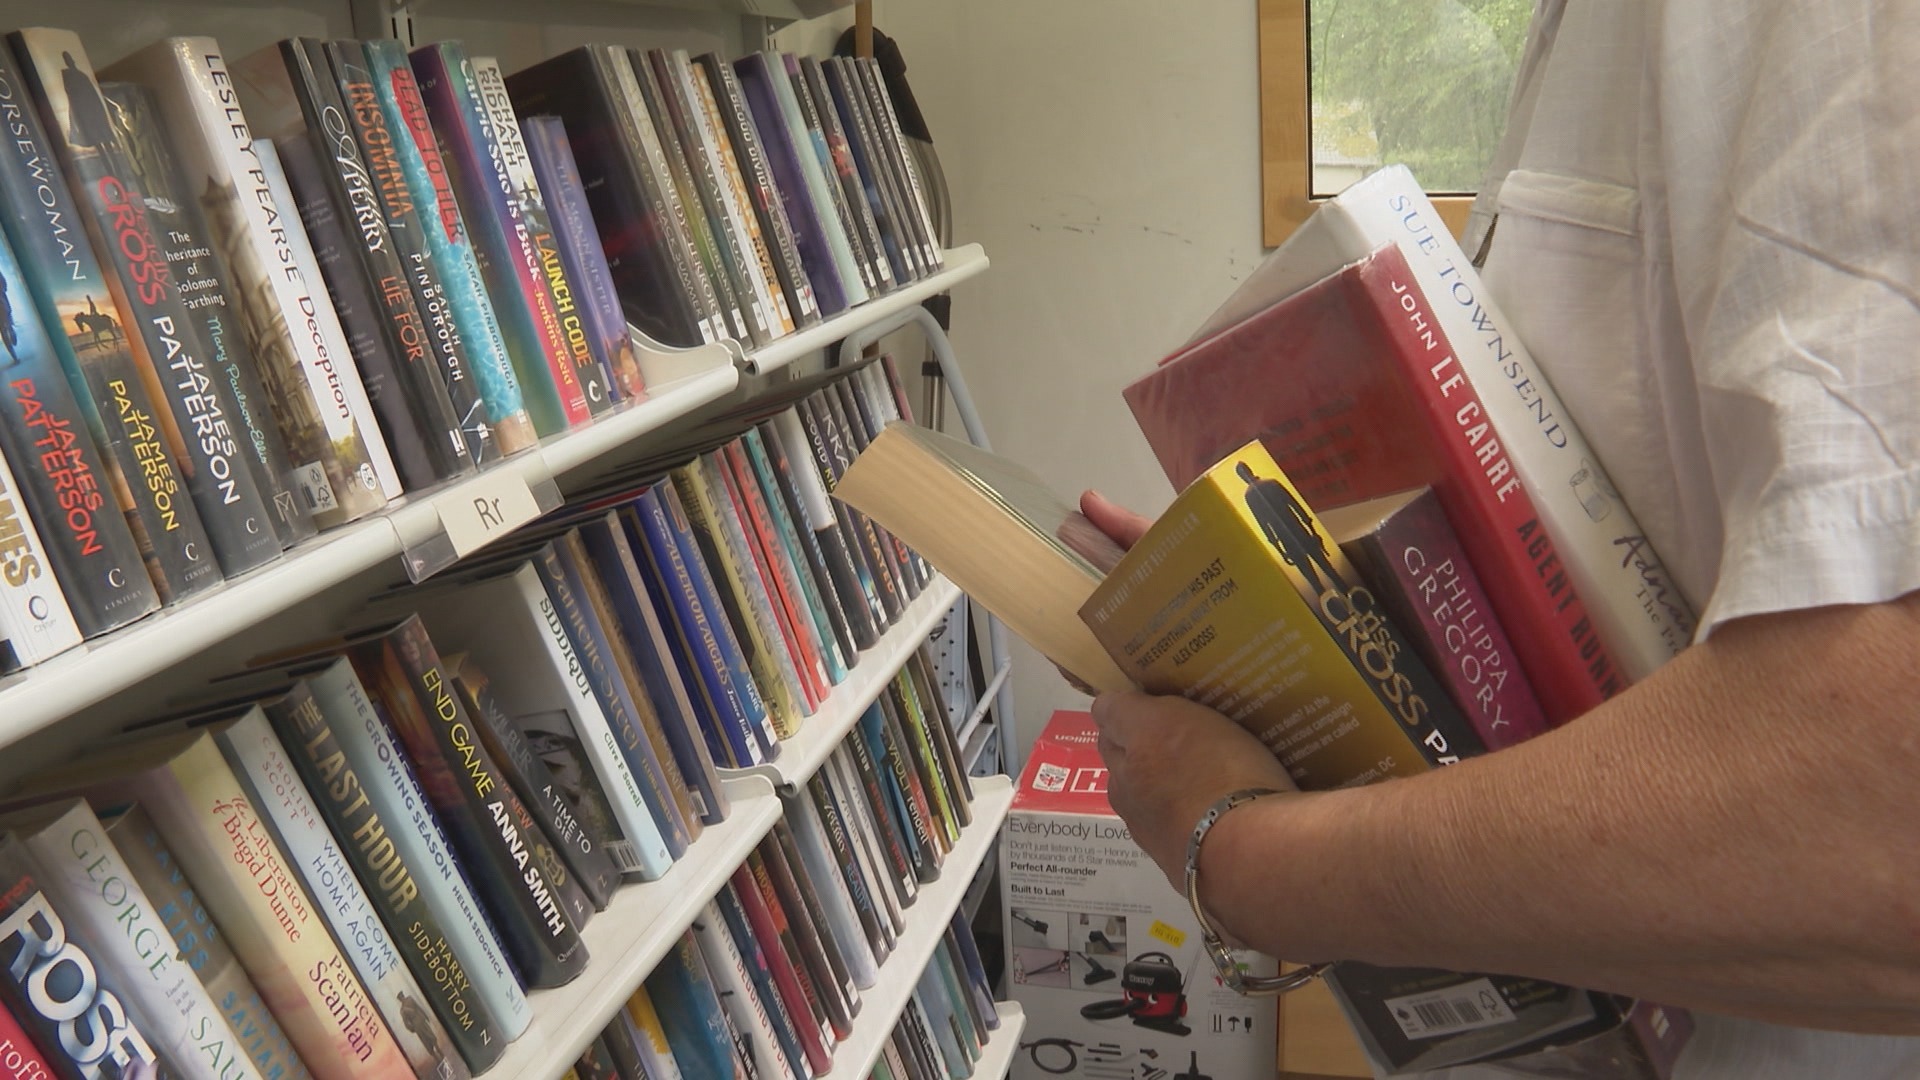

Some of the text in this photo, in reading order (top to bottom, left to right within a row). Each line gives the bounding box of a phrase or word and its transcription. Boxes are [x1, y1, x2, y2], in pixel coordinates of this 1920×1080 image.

[346, 82, 414, 218] INSOMNIA
[393, 67, 427, 132] DEAD
[421, 145, 442, 175] TO
[437, 187, 469, 244] HER
[478, 71, 517, 166] RIDPATH
[488, 67, 527, 168] MICHAEL
[343, 171, 388, 255] PERRY
[460, 59, 542, 285] Carrie Soto is Back
[745, 147, 773, 195] DIVIDE
[777, 238, 804, 286] DHAND
[100, 176, 166, 305] CROSS
[169, 231, 190, 244] The
[187, 264, 199, 276] of
[204, 54, 257, 158] LESLEY
[248, 169, 300, 283] PEARSE
[298, 295, 350, 419] Deception
[654, 200, 706, 319] BLACK SUMMER
[718, 217, 758, 292] LEGACY
[207, 315, 228, 363] Mary
[381, 276, 403, 307] LIE
[394, 312, 424, 362] FOR
[411, 253, 463, 382] PINBOROUGH
[434, 284, 461, 345] SARAH
[464, 254, 515, 390] SARAH PINBOROUGH
[535, 234, 575, 314] LAUNCH
[564, 315, 593, 368] CODE
[1389, 195, 1568, 450] SUE TOWNSEND
[153, 315, 241, 505] PATTERSON
[184, 356, 237, 457] JAMES
[556, 351, 573, 385] Reid
[10, 378, 103, 556] PATTERSON
[50, 414, 104, 512] JAMES
[109, 380, 180, 531] PATTERSON
[132, 410, 179, 495] JAMES
[802, 414, 828, 463] COULD
[1391, 279, 1583, 612] JOHN LE CARRÉ AGENT
[474, 498, 504, 530] Rr
[731, 565, 777, 654] JAMES
[765, 538, 811, 623] JAMES
[783, 528, 828, 612] JAMES
[1186, 558, 1226, 596] HIS PAST
[1633, 584, 1662, 622] The
[1147, 617, 1194, 659] EVERYTHING
[1207, 578, 1238, 606] FROM
[1171, 624, 1219, 667] ALEX CROSS?
[1319, 589, 1430, 726] CROSS
[1347, 586, 1400, 664] Criss
[1403, 545, 1509, 731] GREGORY
[1435, 558, 1508, 692] PHILIPPA
[540, 598, 642, 807] SIDDIQUI Clive Sorrell
[744, 683, 760, 711] HARE
[1312, 698, 1353, 734] campaign
[1313, 691, 1330, 710] the
[1332, 715, 1360, 740] called
[260, 737, 317, 829] CAROLINE
[260, 760, 300, 820] SCOTT
[285, 696, 421, 912] THE LAST HOUR
[420, 667, 567, 936] END GAME ANNA SMITH
[540, 783, 593, 855] A TIME TO
[902, 796, 932, 844] rendell
[230, 794, 311, 922] The Liberation
[343, 680, 368, 716] THE
[362, 718, 416, 809] GROWING
[410, 811, 453, 880] SEASON
[451, 886, 474, 921] HELEN
[470, 922, 504, 978] SEDGWICK
[551, 814, 574, 845] DIE
[1009, 817, 1090, 841] Everybody
[1010, 862, 1097, 876] Perfect All-rounder
[1022, 852, 1068, 863] thousands
[1086, 855, 1103, 866] Star
[1105, 857, 1138, 868] reviews
[1104, 847, 1130, 859] Henry
[71, 828, 172, 981] GEORGE
[144, 832, 217, 941] SAVAGE
[217, 815, 264, 879] Brigid
[258, 876, 304, 944] Dunne
[310, 856, 388, 981] HOME AGAIN
[319, 840, 359, 899] WHEN
[361, 913, 401, 972] COME
[1010, 884, 1065, 898] Built to Last
[160, 901, 209, 970] KISS
[408, 922, 474, 1031] SIDEBOTTOM
[433, 936, 469, 992] HARRY
[307, 962, 376, 1062] Scanlan
[327, 955, 381, 1038] Patricia
